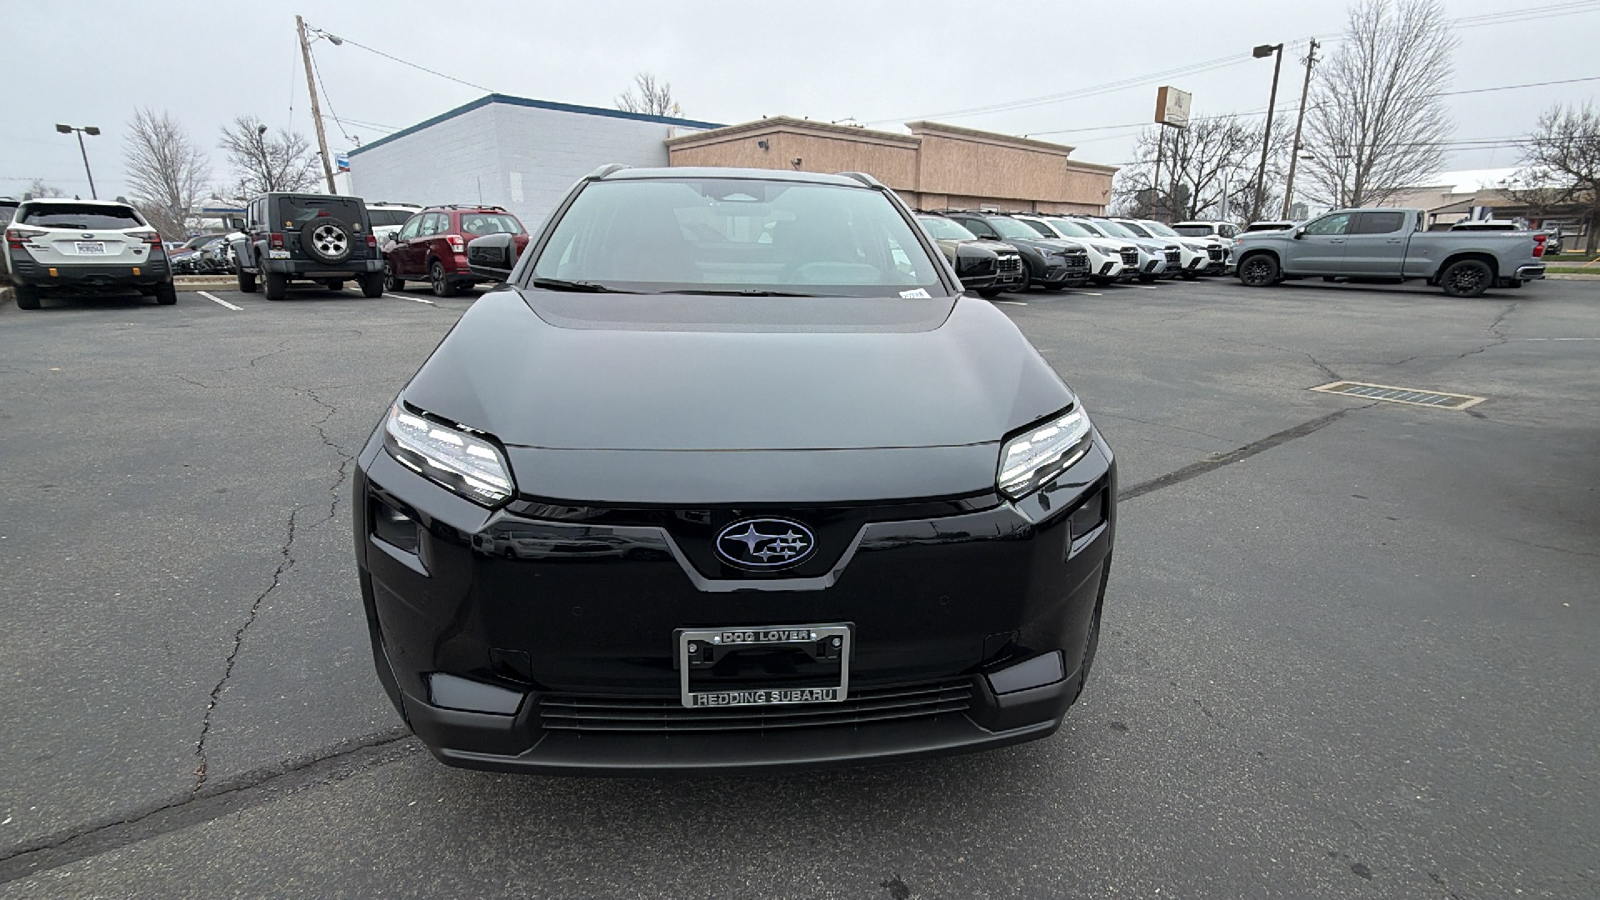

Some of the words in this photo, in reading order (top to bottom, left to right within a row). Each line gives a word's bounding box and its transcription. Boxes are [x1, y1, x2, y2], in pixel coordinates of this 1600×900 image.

[722, 632, 755, 642] DOG
[759, 630, 809, 641] LOVER
[698, 692, 766, 705] REDDING
[770, 690, 832, 702] SUBARU
